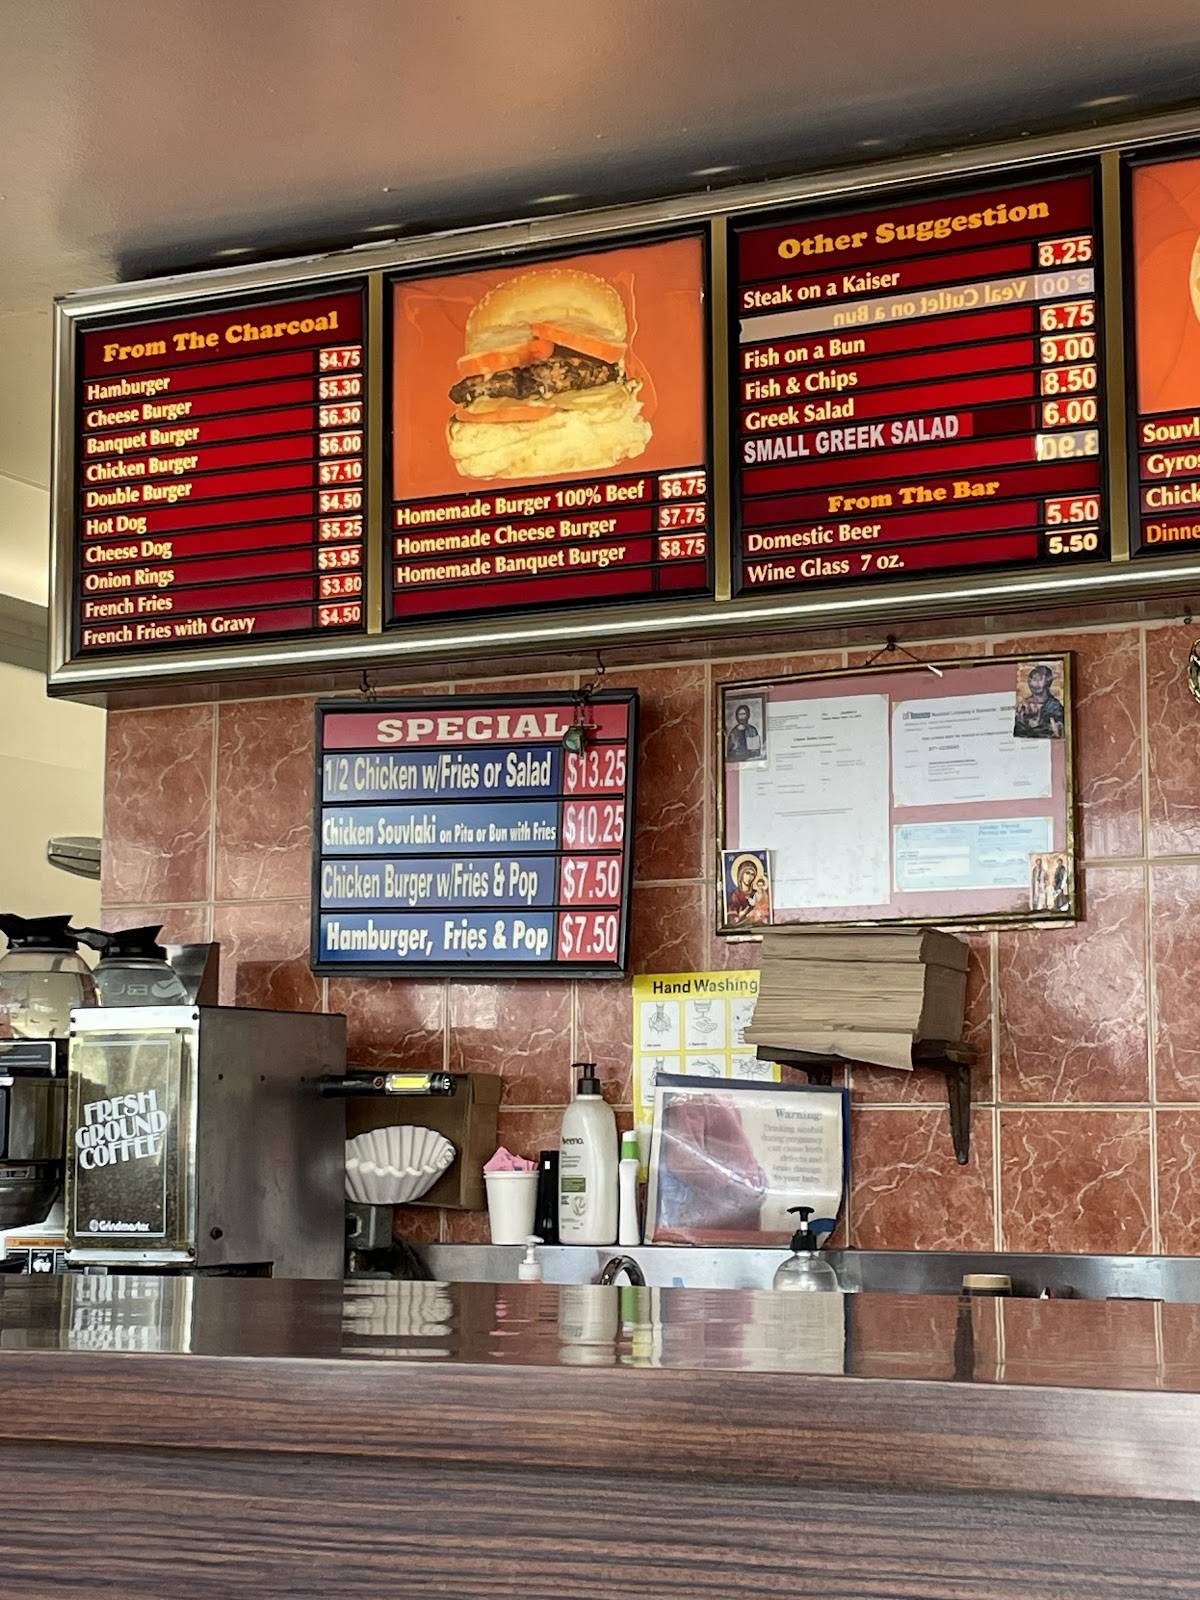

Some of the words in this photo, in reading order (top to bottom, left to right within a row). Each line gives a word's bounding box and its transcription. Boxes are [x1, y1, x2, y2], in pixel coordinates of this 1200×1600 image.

[779, 232, 867, 258] Other
[875, 202, 1049, 243] Suggestion
[1038, 239, 1092, 266] 8.25
[744, 285, 792, 308] Steak
[798, 286, 820, 300] on
[827, 283, 837, 296] a
[843, 272, 899, 293] Kaiser
[1040, 304, 1094, 330] 6.75
[104, 341, 166, 362] From
[173, 332, 218, 351] The
[226, 311, 338, 343] Charcoal
[1040, 336, 1095, 363] 9.00
[320, 351, 360, 369] $4.75
[745, 348, 779, 369] Fish
[785, 348, 808, 363] on
[813, 346, 824, 358] a
[830, 339, 865, 356] Bun
[88, 378, 170, 400] Hamburger
[319, 377, 362, 399] $5.30
[746, 379, 780, 400] Fish
[786, 377, 800, 394] &
[805, 370, 857, 391] Chips
[1041, 368, 1096, 395] 8.50
[87, 410, 139, 427] Cheese
[143, 402, 192, 420] Burger
[320, 406, 362, 427] $6.30
[746, 406, 799, 429] Greek
[804, 398, 854, 422] Salad
[1043, 399, 1096, 425] 6.00
[88, 432, 147, 454] Banquet
[150, 428, 199, 446] Burger
[320, 433, 363, 455] $6.00
[745, 435, 809, 463] SMALL
[816, 424, 884, 453] GREEK
[892, 416, 958, 444] SALAD
[87, 456, 145, 481] Chicken
[149, 456, 198, 474] Burger
[319, 462, 362, 483] $7.10
[87, 487, 139, 507] Double
[143, 484, 192, 502] Burger
[662, 478, 706, 498] $6.75
[828, 494, 892, 512] From
[899, 487, 946, 504] The
[953, 482, 999, 498] Bar
[319, 491, 362, 512] $4.50
[397, 499, 490, 525] Homemade
[496, 497, 551, 515] Burger
[555, 486, 601, 507] 100%
[606, 480, 644, 501] Beef
[1047, 500, 1098, 524] 5.50
[87, 518, 113, 535] Hot
[117, 516, 146, 534] Dog
[322, 521, 362, 540] $5.25
[661, 508, 705, 527] $7.75
[397, 529, 490, 554] Homemade
[495, 525, 555, 544] Cheese
[560, 520, 616, 538] Burger
[661, 539, 705, 559] $8.75
[749, 526, 833, 551] Domestic
[839, 525, 881, 541] Beer
[1049, 533, 1097, 554] 5.50
[86, 546, 138, 562] Cheese
[141, 541, 172, 559] Dog
[319, 548, 362, 569] $3.95
[398, 558, 490, 583] Homemade
[495, 551, 564, 574] Banquet
[569, 547, 625, 567] Burger
[748, 564, 795, 582] Wine
[801, 558, 849, 577] Glass
[861, 555, 872, 571] 7
[877, 555, 904, 569] oz.
[86, 572, 131, 590] Onion
[135, 568, 174, 587] Rings
[320, 575, 362, 597] $3.80
[86, 598, 133, 617] French
[138, 595, 172, 612] Fries
[318, 604, 361, 625] $4.50
[84, 626, 132, 645] French
[137, 623, 171, 640] Fries
[175, 618, 207, 636] with
[211, 617, 255, 633] Gravy
[376, 713, 569, 743] SPECIAL
[325, 758, 349, 791] 1/2
[354, 756, 417, 791] Chicken
[423, 755, 479, 792] w/Fries
[484, 761, 502, 787] or
[506, 751, 552, 787] Salad
[567, 749, 626, 791] $13.25
[322, 817, 374, 846] Chicken
[377, 815, 436, 845] Souvlaki
[440, 830, 452, 844] on
[454, 823, 473, 843] Pita
[476, 828, 486, 842] or
[489, 824, 507, 842] Bun
[510, 821, 531, 840] with
[533, 820, 556, 840] Fries
[565, 805, 624, 845] $10.25
[322, 864, 380, 899] Chicken
[384, 863, 433, 906] Burger
[437, 863, 488, 901] w/Fries
[494, 862, 505, 897] &
[509, 863, 537, 905] Pop
[563, 860, 620, 901] $7.50
[326, 920, 433, 956] Hamburger,
[444, 919, 486, 950] Fries
[493, 921, 507, 950] &
[513, 920, 548, 955] Pop
[561, 914, 617, 957] $7.50
[653, 980, 691, 994] Hand
[694, 978, 758, 994] Washing
[84, 1089, 157, 1126] FRESH
[75, 1110, 167, 1148] GROUND
[79, 1132, 161, 1169] COFFEE
